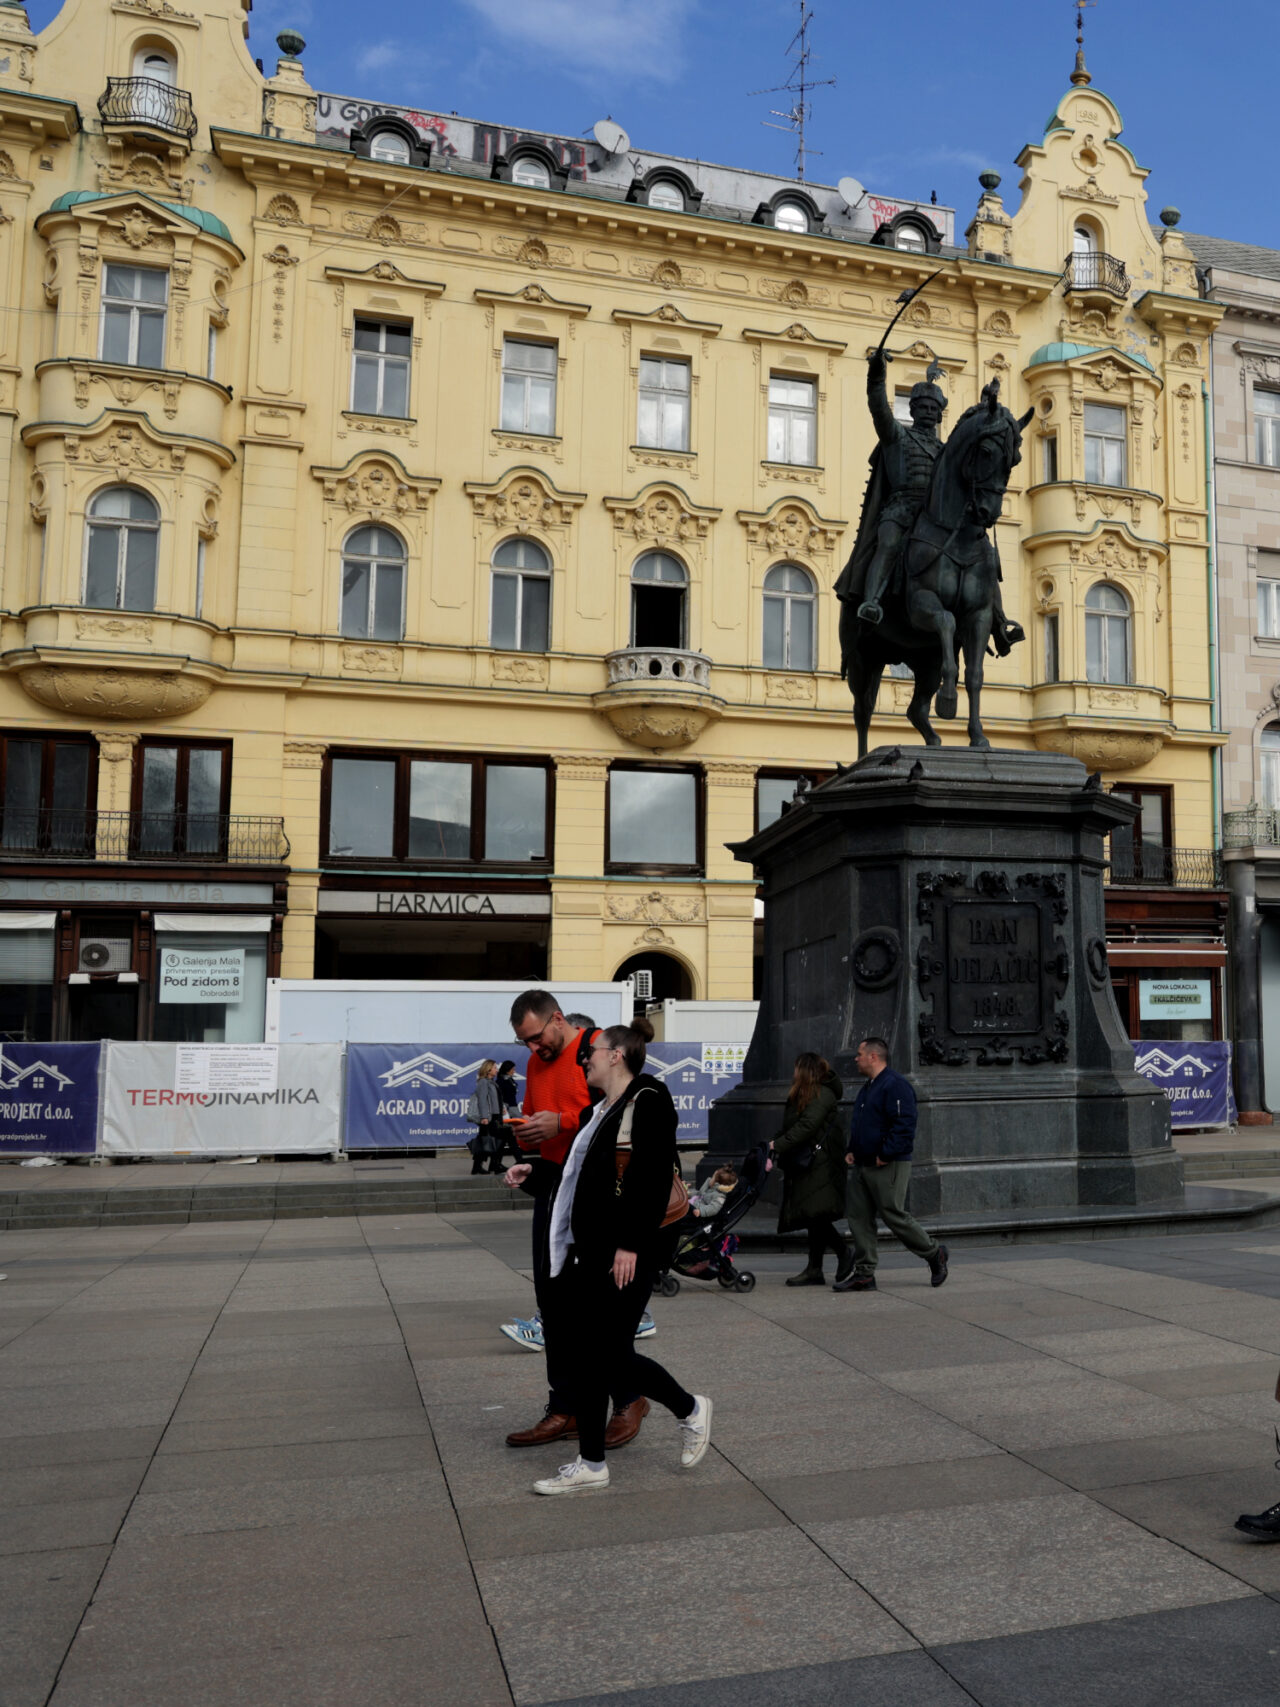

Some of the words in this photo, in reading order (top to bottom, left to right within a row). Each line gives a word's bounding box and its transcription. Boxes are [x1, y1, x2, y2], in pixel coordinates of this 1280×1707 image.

[42, 880, 144, 901] Galerija
[166, 883, 225, 902] Mala
[376, 893, 496, 914] HARMICA
[968, 919, 1017, 945] BAN
[182, 957, 217, 967] Galerija
[220, 957, 240, 966] Mala
[164, 976, 188, 987] Pod
[192, 976, 229, 987] zidom
[232, 976, 240, 987] 8
[44, 1103, 74, 1119] d.o.o.
[376, 1100, 426, 1116] AGRAD
